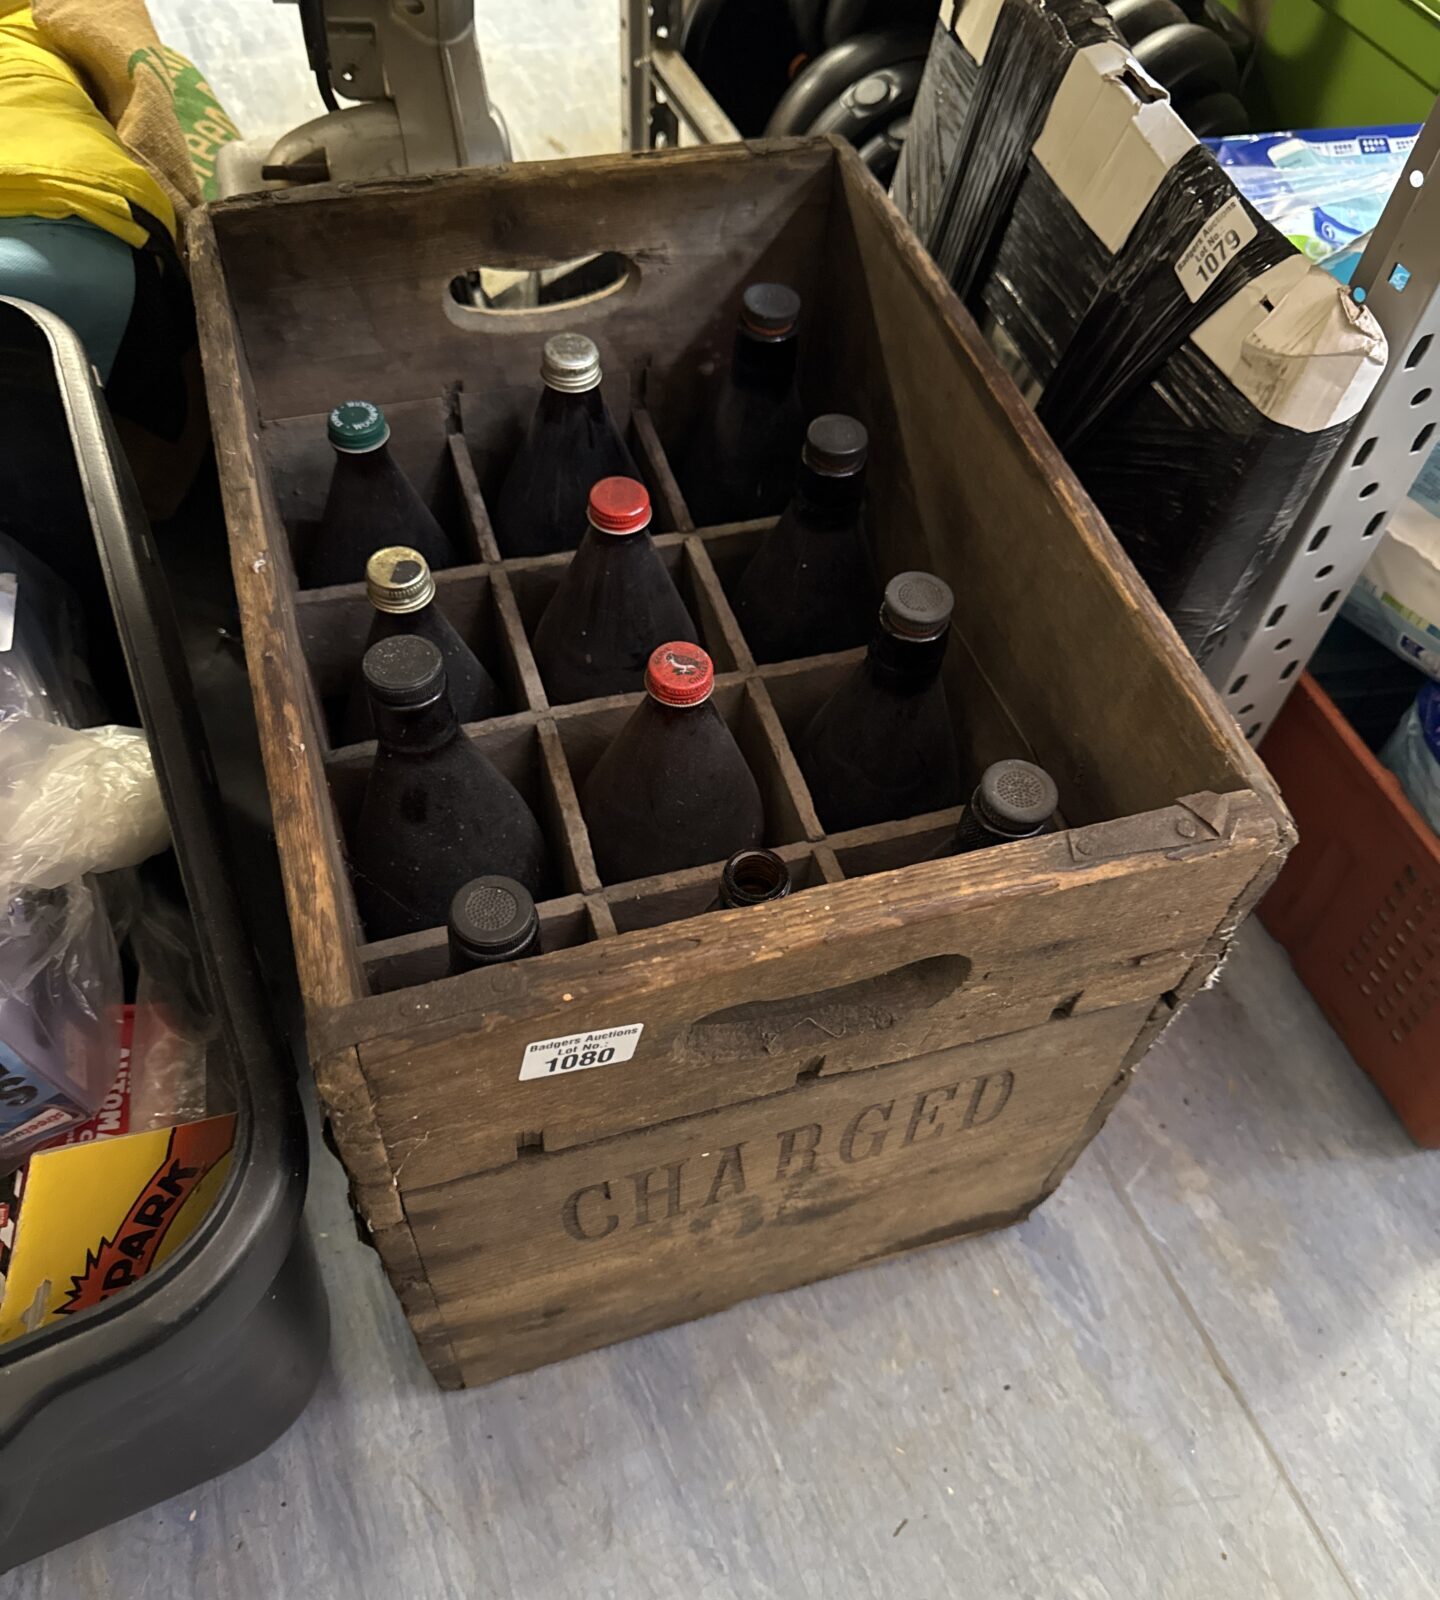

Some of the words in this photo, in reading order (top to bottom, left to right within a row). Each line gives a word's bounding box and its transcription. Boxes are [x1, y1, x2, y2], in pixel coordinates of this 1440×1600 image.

[1203, 202, 1236, 238] Auctions
[1195, 246, 1208, 262] Lot
[1196, 229, 1241, 282] 1079
[530, 1037, 581, 1053] Badgers
[585, 1028, 639, 1042] Auctions
[558, 1046, 578, 1056] Lot
[545, 1047, 616, 1072] 1080
[561, 1069, 1015, 1244] CHARGED
[101, 1158, 199, 1300] PARK
